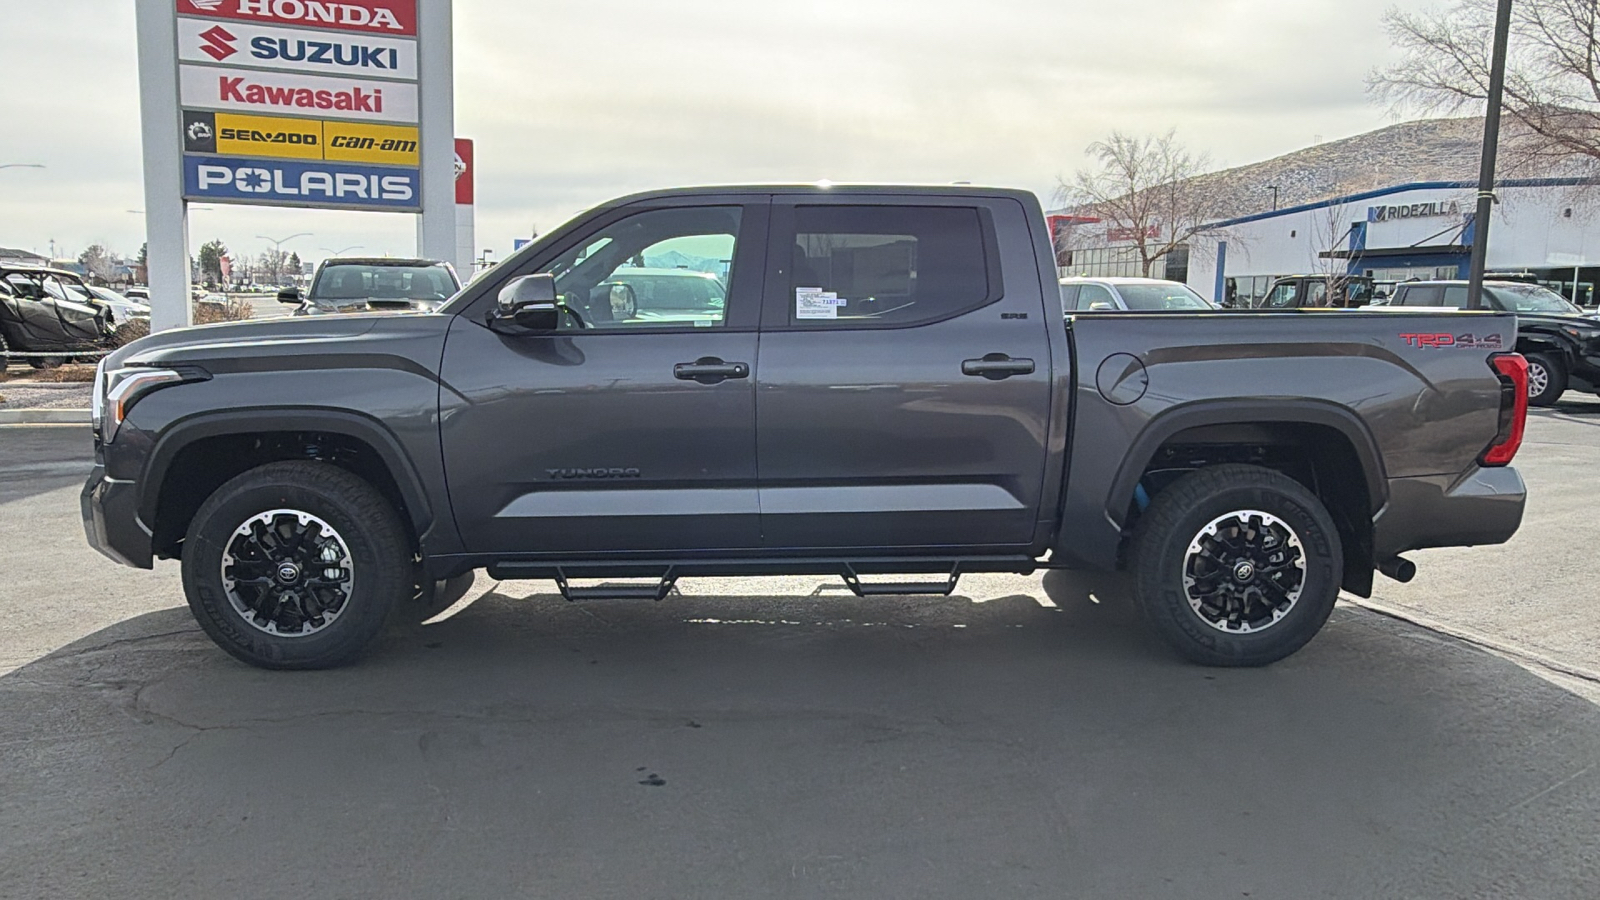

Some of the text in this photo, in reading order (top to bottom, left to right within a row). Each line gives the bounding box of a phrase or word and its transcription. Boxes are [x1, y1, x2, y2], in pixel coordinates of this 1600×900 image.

[236, 0, 403, 30] HONDA
[250, 36, 397, 70] SUZUKI
[219, 76, 382, 113] Kawasaki
[198, 165, 413, 200] POLARIS
[1388, 201, 1458, 219] RIDEZILLA
[1400, 333, 1454, 348] TRD
[545, 468, 640, 479] TUNDRA
